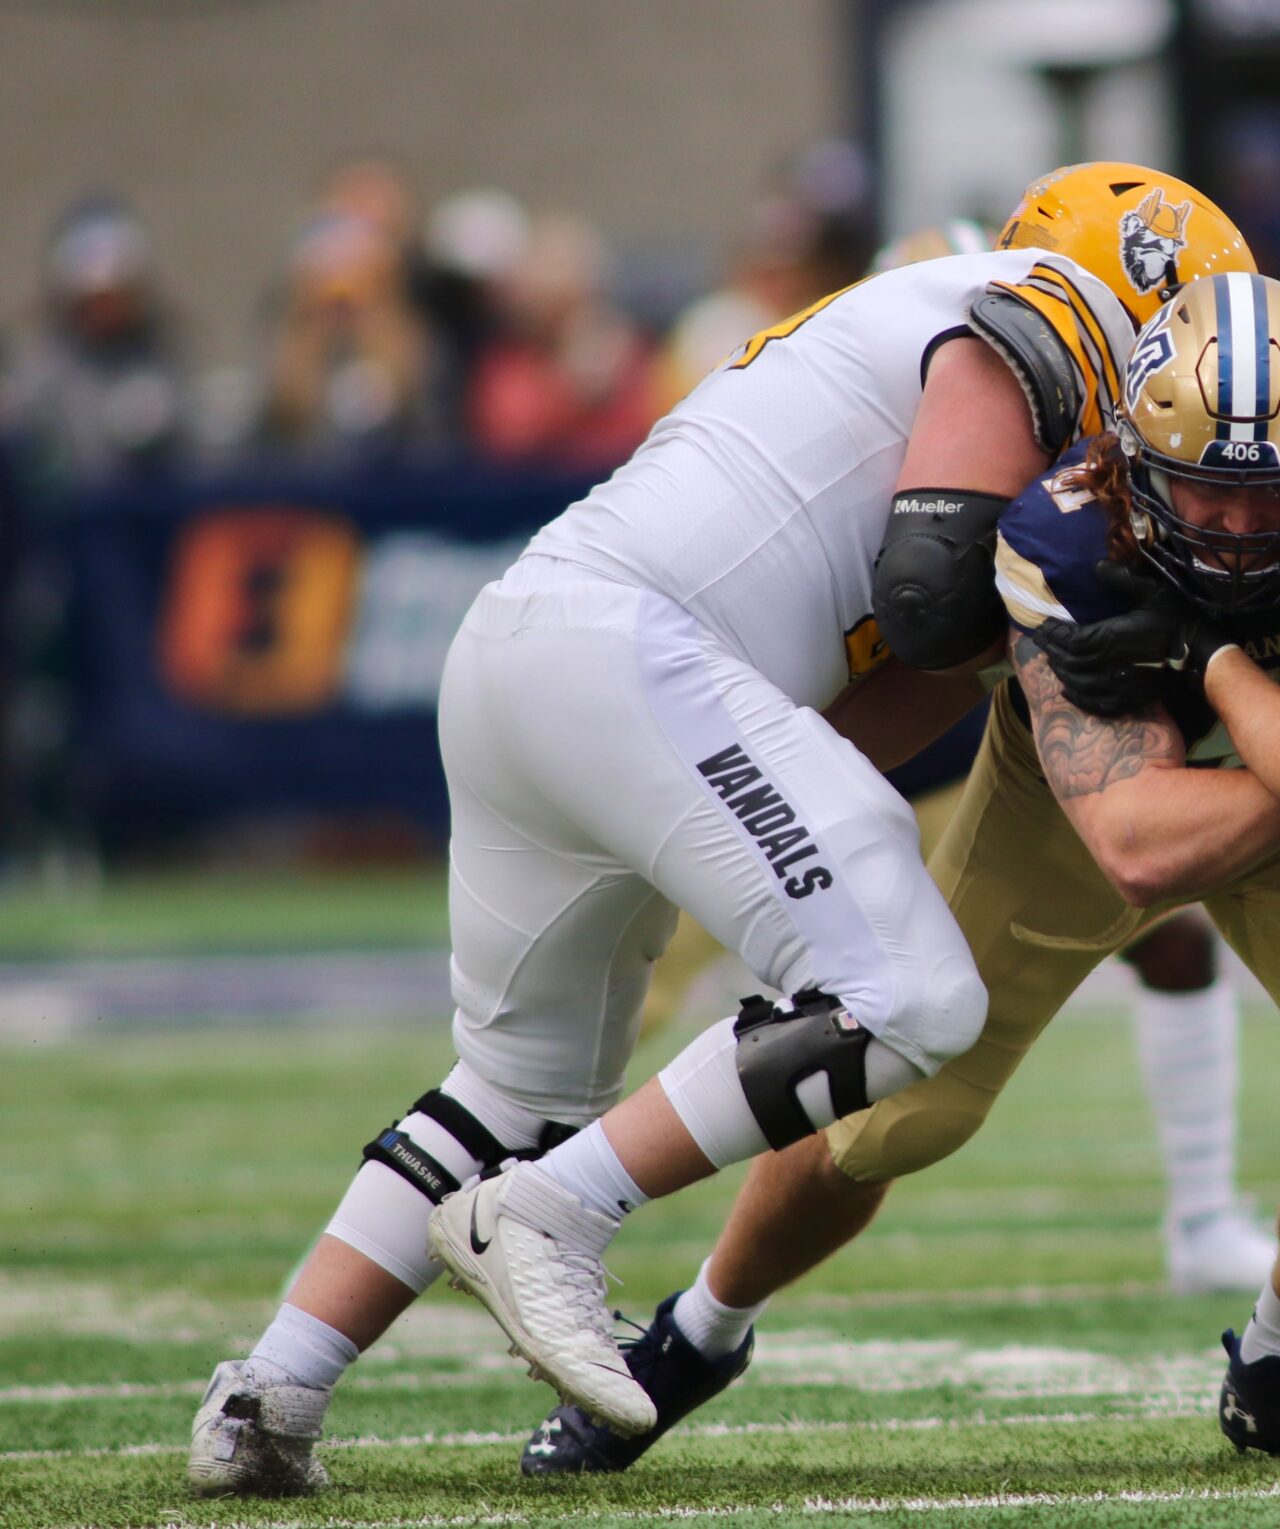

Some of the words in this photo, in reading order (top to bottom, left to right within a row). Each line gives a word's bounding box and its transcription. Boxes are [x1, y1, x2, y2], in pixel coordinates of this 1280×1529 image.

[1221, 444, 1260, 461] 406
[897, 499, 965, 514] Mueller
[696, 743, 833, 900] VANDALS
[393, 1143, 441, 1189] THUASNE
